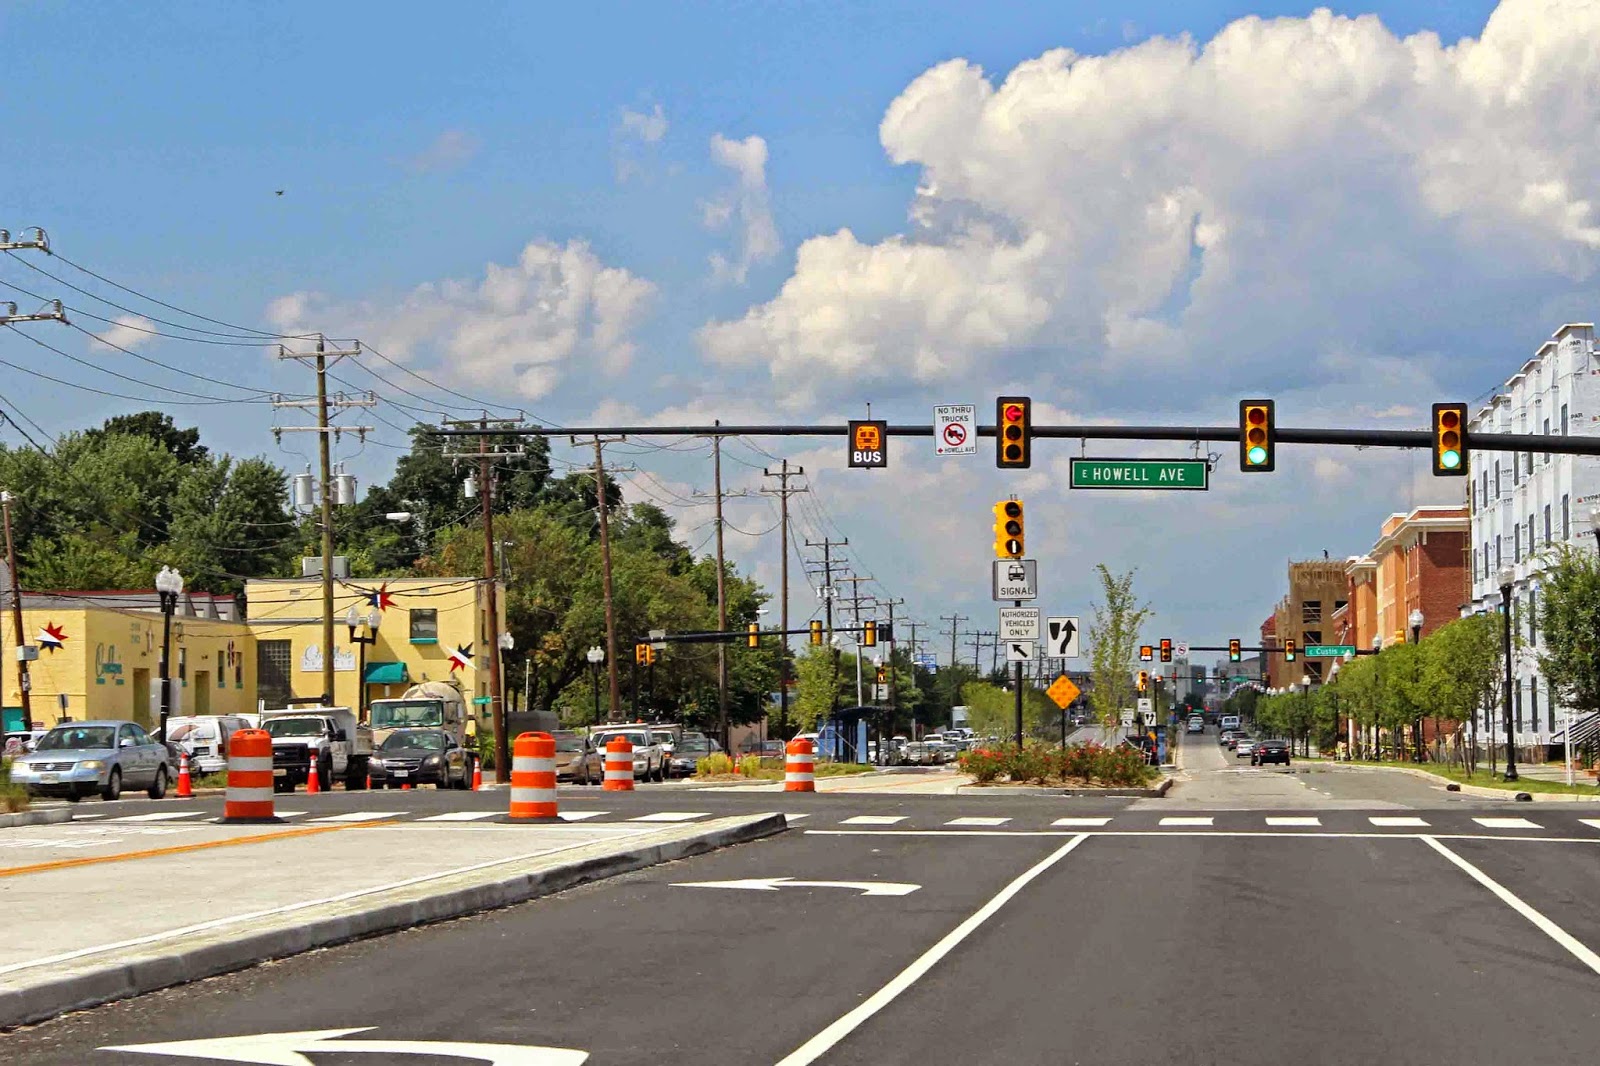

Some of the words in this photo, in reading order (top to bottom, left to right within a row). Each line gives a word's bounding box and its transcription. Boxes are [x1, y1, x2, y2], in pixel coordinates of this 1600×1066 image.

[853, 451, 882, 463] BUS
[1082, 469, 1088, 478] E
[1093, 467, 1149, 481] HOWELL
[1160, 468, 1185, 481] AVE
[1001, 587, 1033, 596] SIGNAL
